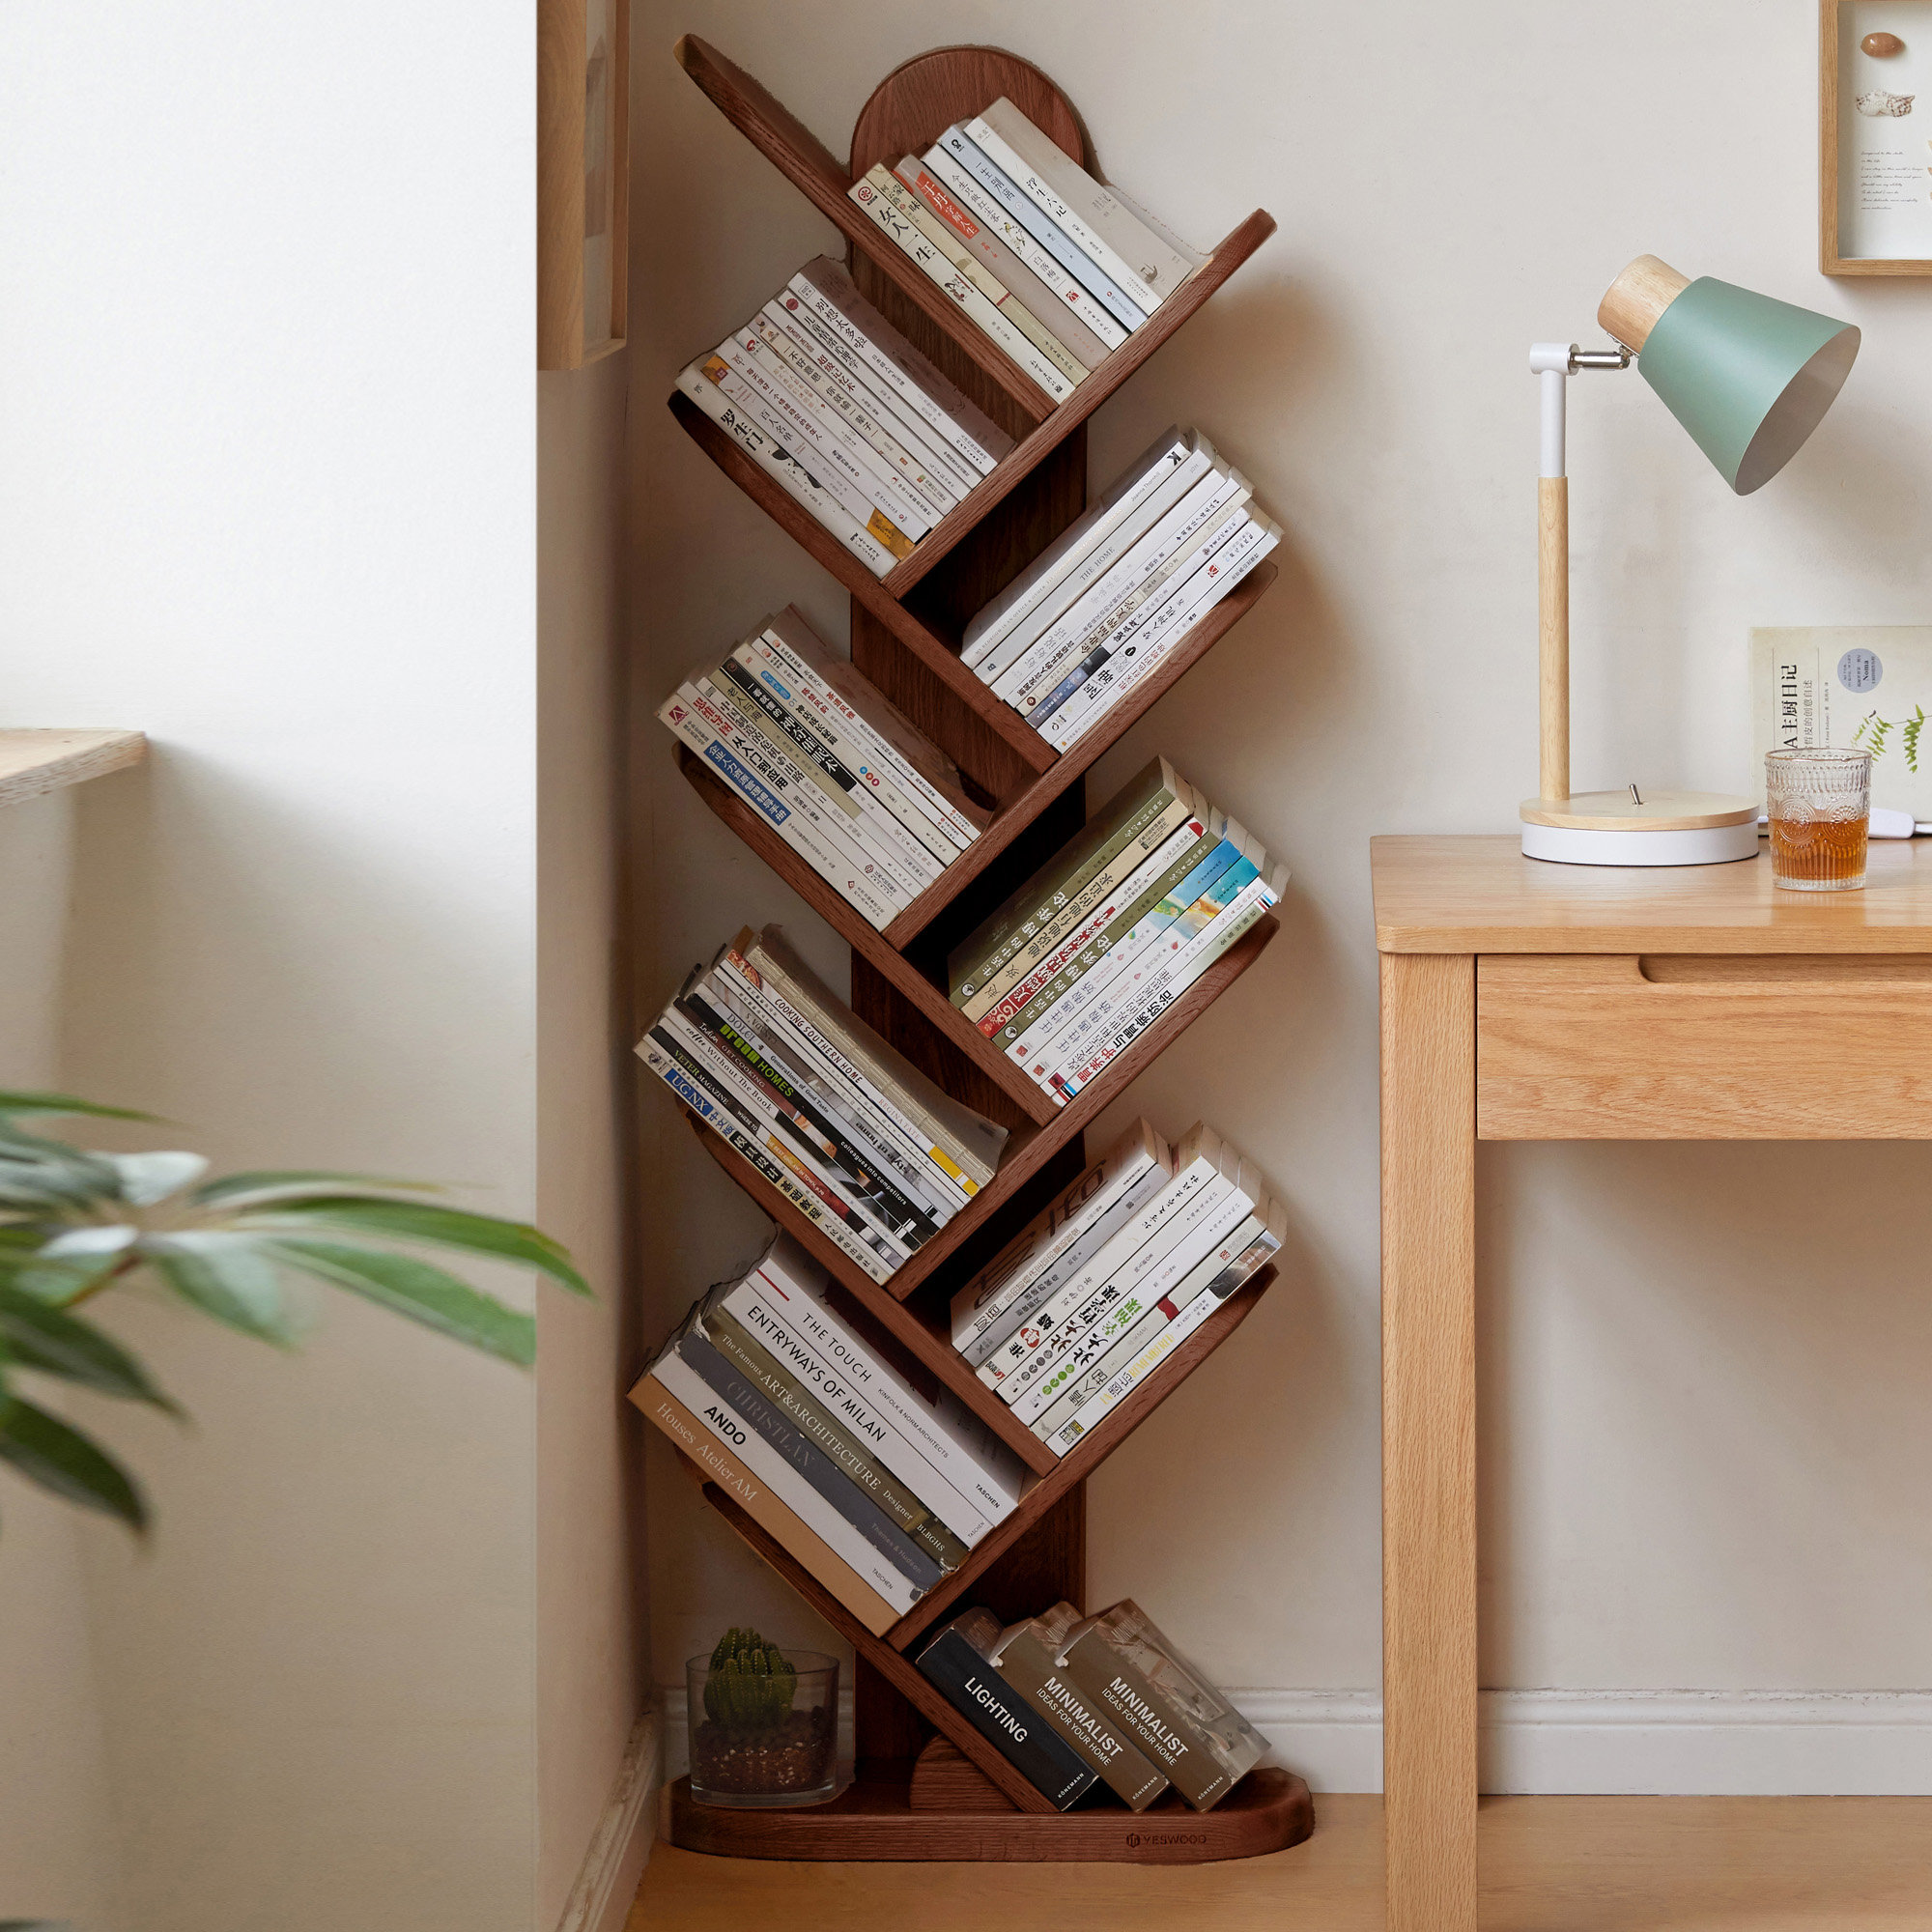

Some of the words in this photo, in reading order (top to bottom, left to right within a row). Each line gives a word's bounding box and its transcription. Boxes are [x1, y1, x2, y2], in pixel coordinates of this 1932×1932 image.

[879, 184, 901, 206] 柯云路
[948, 172, 1003, 224] 今生只做红尘客
[972, 160, 1016, 204] 一生别离
[1024, 176, 1067, 217] 浮生六记
[872, 203, 937, 266] 女人一生
[1031, 254, 1057, 279] 白落梅
[800, 313, 862, 371] 儿童情绪心理学
[811, 297, 869, 352] 别想太多啦
[814, 353, 858, 393] 超级记忆术
[718, 407, 765, 452] 罗生门
[758, 408, 795, 443] 百人名单
[1129, 486, 1145, 501] Joanna
[1143, 470, 1161, 489] Thornhill
[1166, 450, 1181, 466] K
[1175, 497, 1220, 542] 中国国际广播出版社
[1079, 566, 1094, 582] THE
[1094, 546, 1115, 567] HOME
[1230, 551, 1260, 581] 北京燕山出版社
[1022, 624, 1067, 669] 好好说话
[1077, 596, 1137, 656] 企业品牌美学
[986, 662, 996, 671] B
[1016, 639, 1075, 696] 新闻发言人的礼貌语言
[1081, 665, 1117, 700] 阳神
[724, 685, 764, 724] 老人与海
[745, 682, 783, 719] 一看就懂的
[776, 715, 841, 776] 神奇催眠术
[793, 702, 839, 746] 神店成长秘籍
[824, 690, 857, 721] 茶道风雅
[1804, 680, 1813, 750] 哲皮的创意自述
[691, 696, 734, 737] 思维导图
[728, 734, 790, 792] 从入门到应用
[702, 743, 790, 825] 企业人力资源管理辅导手册
[979, 889, 1070, 980] 生活中的博弈论
[1024, 869, 1115, 960] 她说她有她的追求
[1218, 908, 1258, 947] 金盾出版社
[1009, 898, 1119, 1008] 美德就是你的资本
[1022, 932, 1113, 1023] 生活中的博弈论
[1037, 978, 1095, 1037] 任性遇傲娇
[1054, 996, 1114, 1057] 任性遇傲娇
[1065, 966, 1173, 1074] 改变生活和世界的拓展思维
[1075, 986, 1175, 1086] 胃养护与胃病防治
[697, 1021, 721, 1043] Indian
[733, 1056, 767, 1088] COOKING
[773, 997, 805, 1028] COOKING
[802, 1025, 843, 1065] SOUTHERN
[839, 1061, 864, 1084] HOME
[670, 1074, 692, 1095] UG
[687, 1091, 709, 1112] NX
[696, 1073, 729, 1105] MAGAZINE
[735, 1110, 753, 1125] WHERE
[705, 1046, 739, 1078] Without
[736, 1075, 753, 1092] The
[750, 1089, 774, 1112] Book
[769, 1054, 801, 1085] Generations
[804, 1088, 818, 1101] Good
[814, 1098, 831, 1114] Taste
[755, 1060, 796, 1098] HOMES
[838, 1140, 868, 1168] colleagues
[866, 1165, 879, 1178] into
[875, 1175, 908, 1206] competitors
[853, 1120, 879, 1145] home
[877, 1097, 905, 1124] REGINA
[901, 1122, 922, 1141] TATE
[706, 1109, 735, 1137] 中文版
[729, 1133, 781, 1181] 模具设计
[778, 1179, 823, 1222] 基础教程
[1141, 1173, 1200, 1232] 北方文艺出版社
[821, 1221, 871, 1268] 人民邮电出版社
[1047, 1281, 1122, 1355] 北大哲学课
[1069, 1293, 1144, 1369] 北大幸福课
[744, 1304, 828, 1383] ENTRYWAYS
[820, 1378, 846, 1403] OF
[838, 1397, 888, 1443] MILAN
[1105, 1370, 1135, 1400] 遗忘
[800, 1312, 830, 1341] THE
[824, 1337, 873, 1383] TOUCH
[875, 1387, 901, 1411] KINFOLK
[900, 1411, 920, 1429] NORM
[914, 1425, 950, 1459] ARCHITECTS
[973, 1483, 1002, 1509] TASCHEN
[654, 1402, 699, 1445] Houses
[694, 1440, 738, 1482] Atelier
[730, 1475, 757, 1501] AM
[720, 1333, 738, 1350] The
[732, 1346, 765, 1377] Famous
[755, 1371, 885, 1491] ART&ARCHITECTURE
[880, 1489, 915, 1521] Designer
[915, 1522, 947, 1552] BLBGHS
[701, 1402, 749, 1447] ANDO
[869, 1567, 894, 1590] TASCHEN
[896, 1548, 923, 1575] Hudson
[962, 1675, 1030, 1745] LIGHTING
[1035, 1687, 1059, 1712] IDEAS
[1055, 1708, 1072, 1725] FOR
[1068, 1721, 1092, 1745] YOUR
[1087, 1741, 1112, 1766] HOME
[1042, 1675, 1123, 1759] MINIMALIST
[1100, 1687, 1124, 1712] IDEAS
[1121, 1708, 1138, 1725] FOR
[1134, 1722, 1156, 1745] YOUR
[1152, 1741, 1178, 1767] HOME
[1108, 1675, 1189, 1759] MINIMALIST
[1143, 1834, 1208, 1845] YESWOOD
